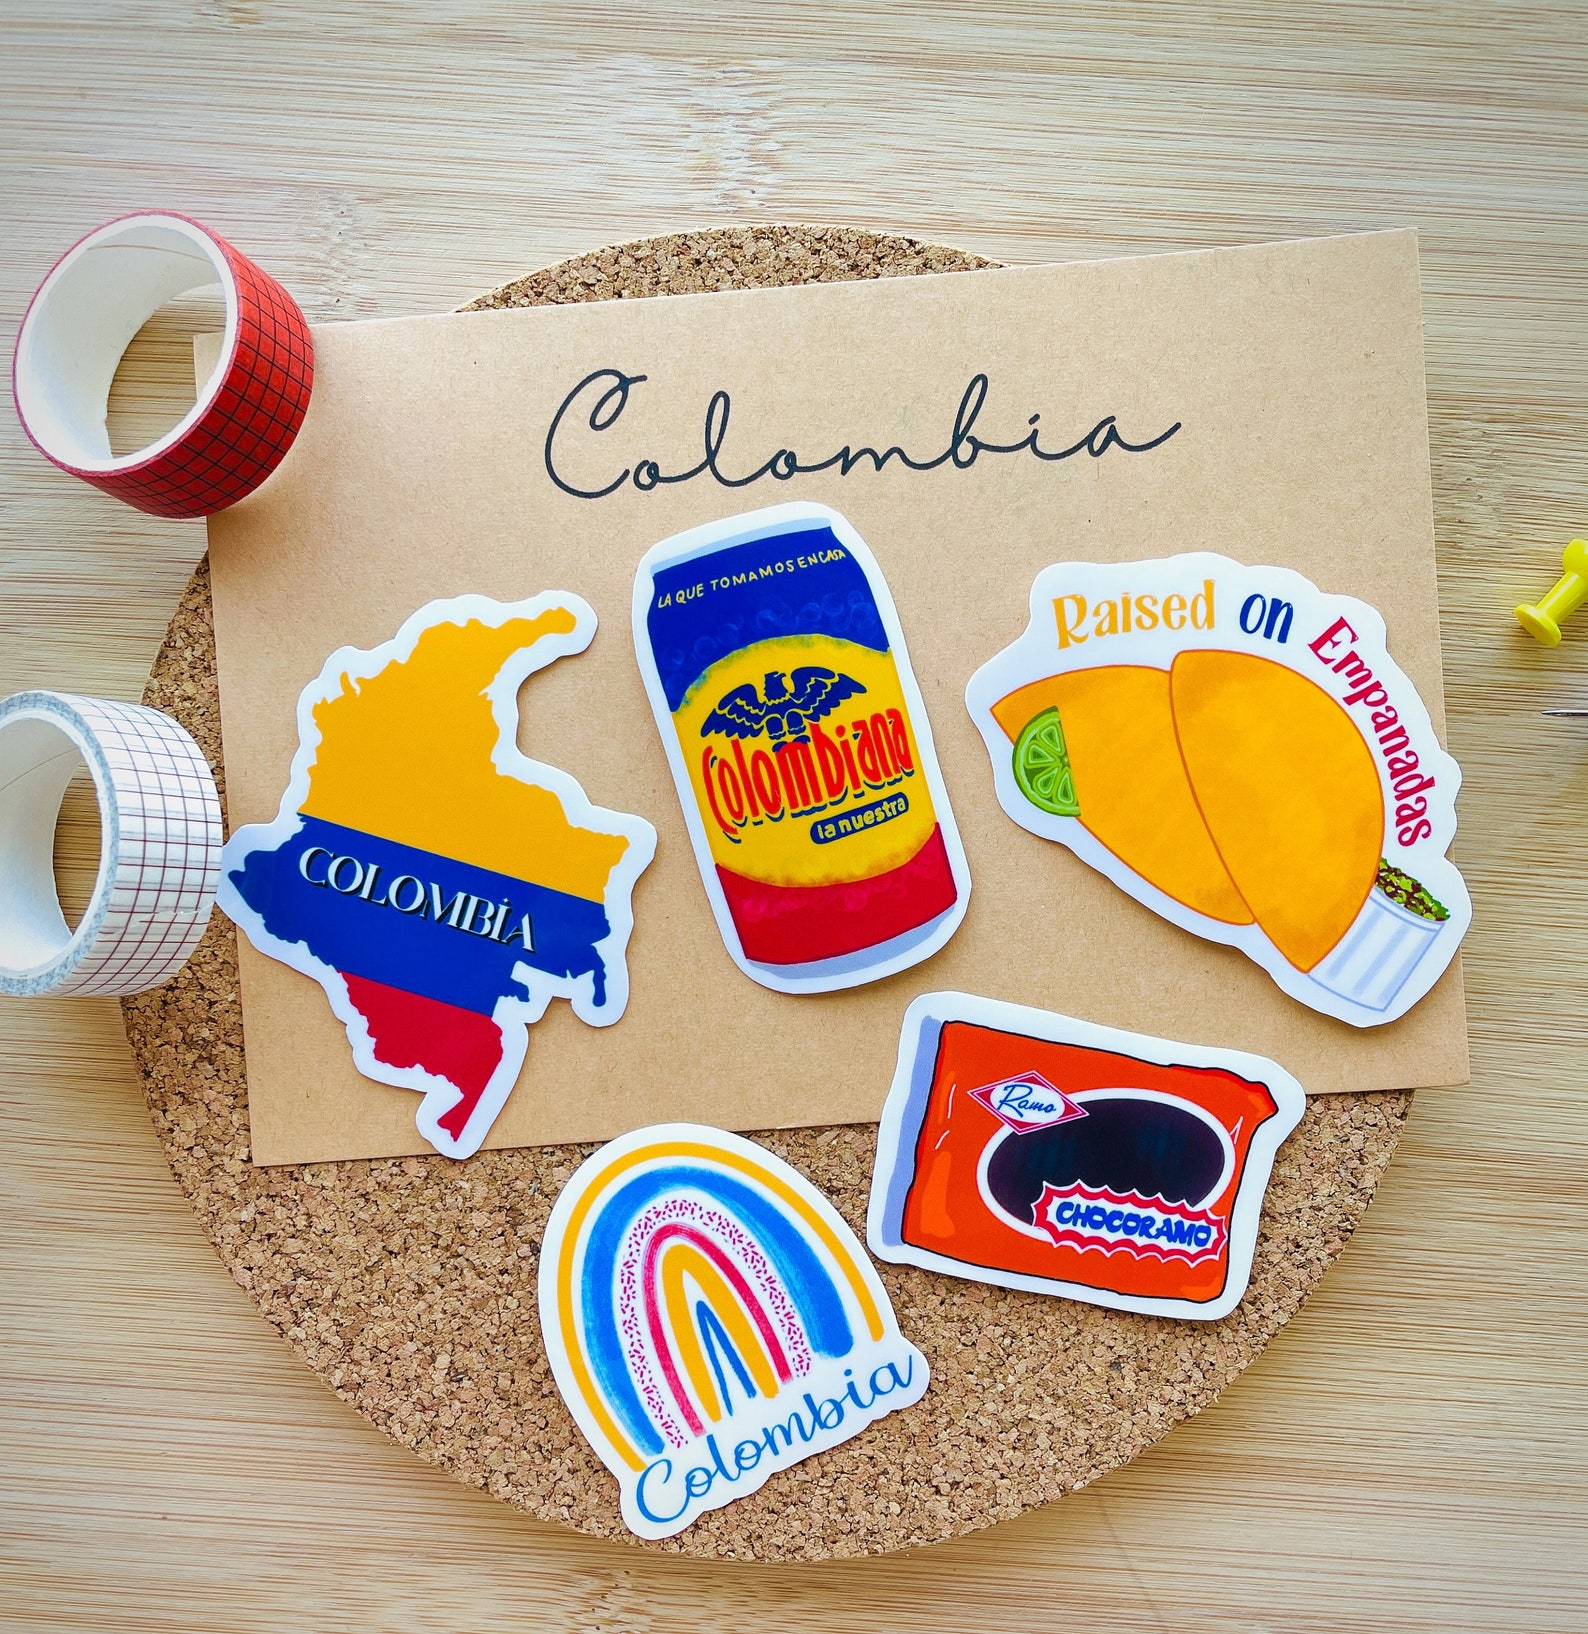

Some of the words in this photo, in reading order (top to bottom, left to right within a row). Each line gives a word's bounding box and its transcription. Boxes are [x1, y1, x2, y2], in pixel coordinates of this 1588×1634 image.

[545, 369, 1182, 498] Colombia
[658, 593, 672, 608] LA
[676, 583, 704, 604] QUE
[710, 559, 795, 591] TOMAMOS
[797, 553, 818, 569] EN
[818, 549, 846, 564] CASA
[1052, 579, 1216, 650] Raised
[1239, 593, 1294, 644] on
[1307, 615, 1436, 848] Empanadas
[702, 708, 914, 843] Colombiana
[817, 821, 837, 839] la
[838, 796, 907, 833] nuestra
[997, 1084, 1057, 1118] Ramo
[1055, 1201, 1212, 1247] CHOCORAMO
[636, 1355, 913, 1523] Colombia
